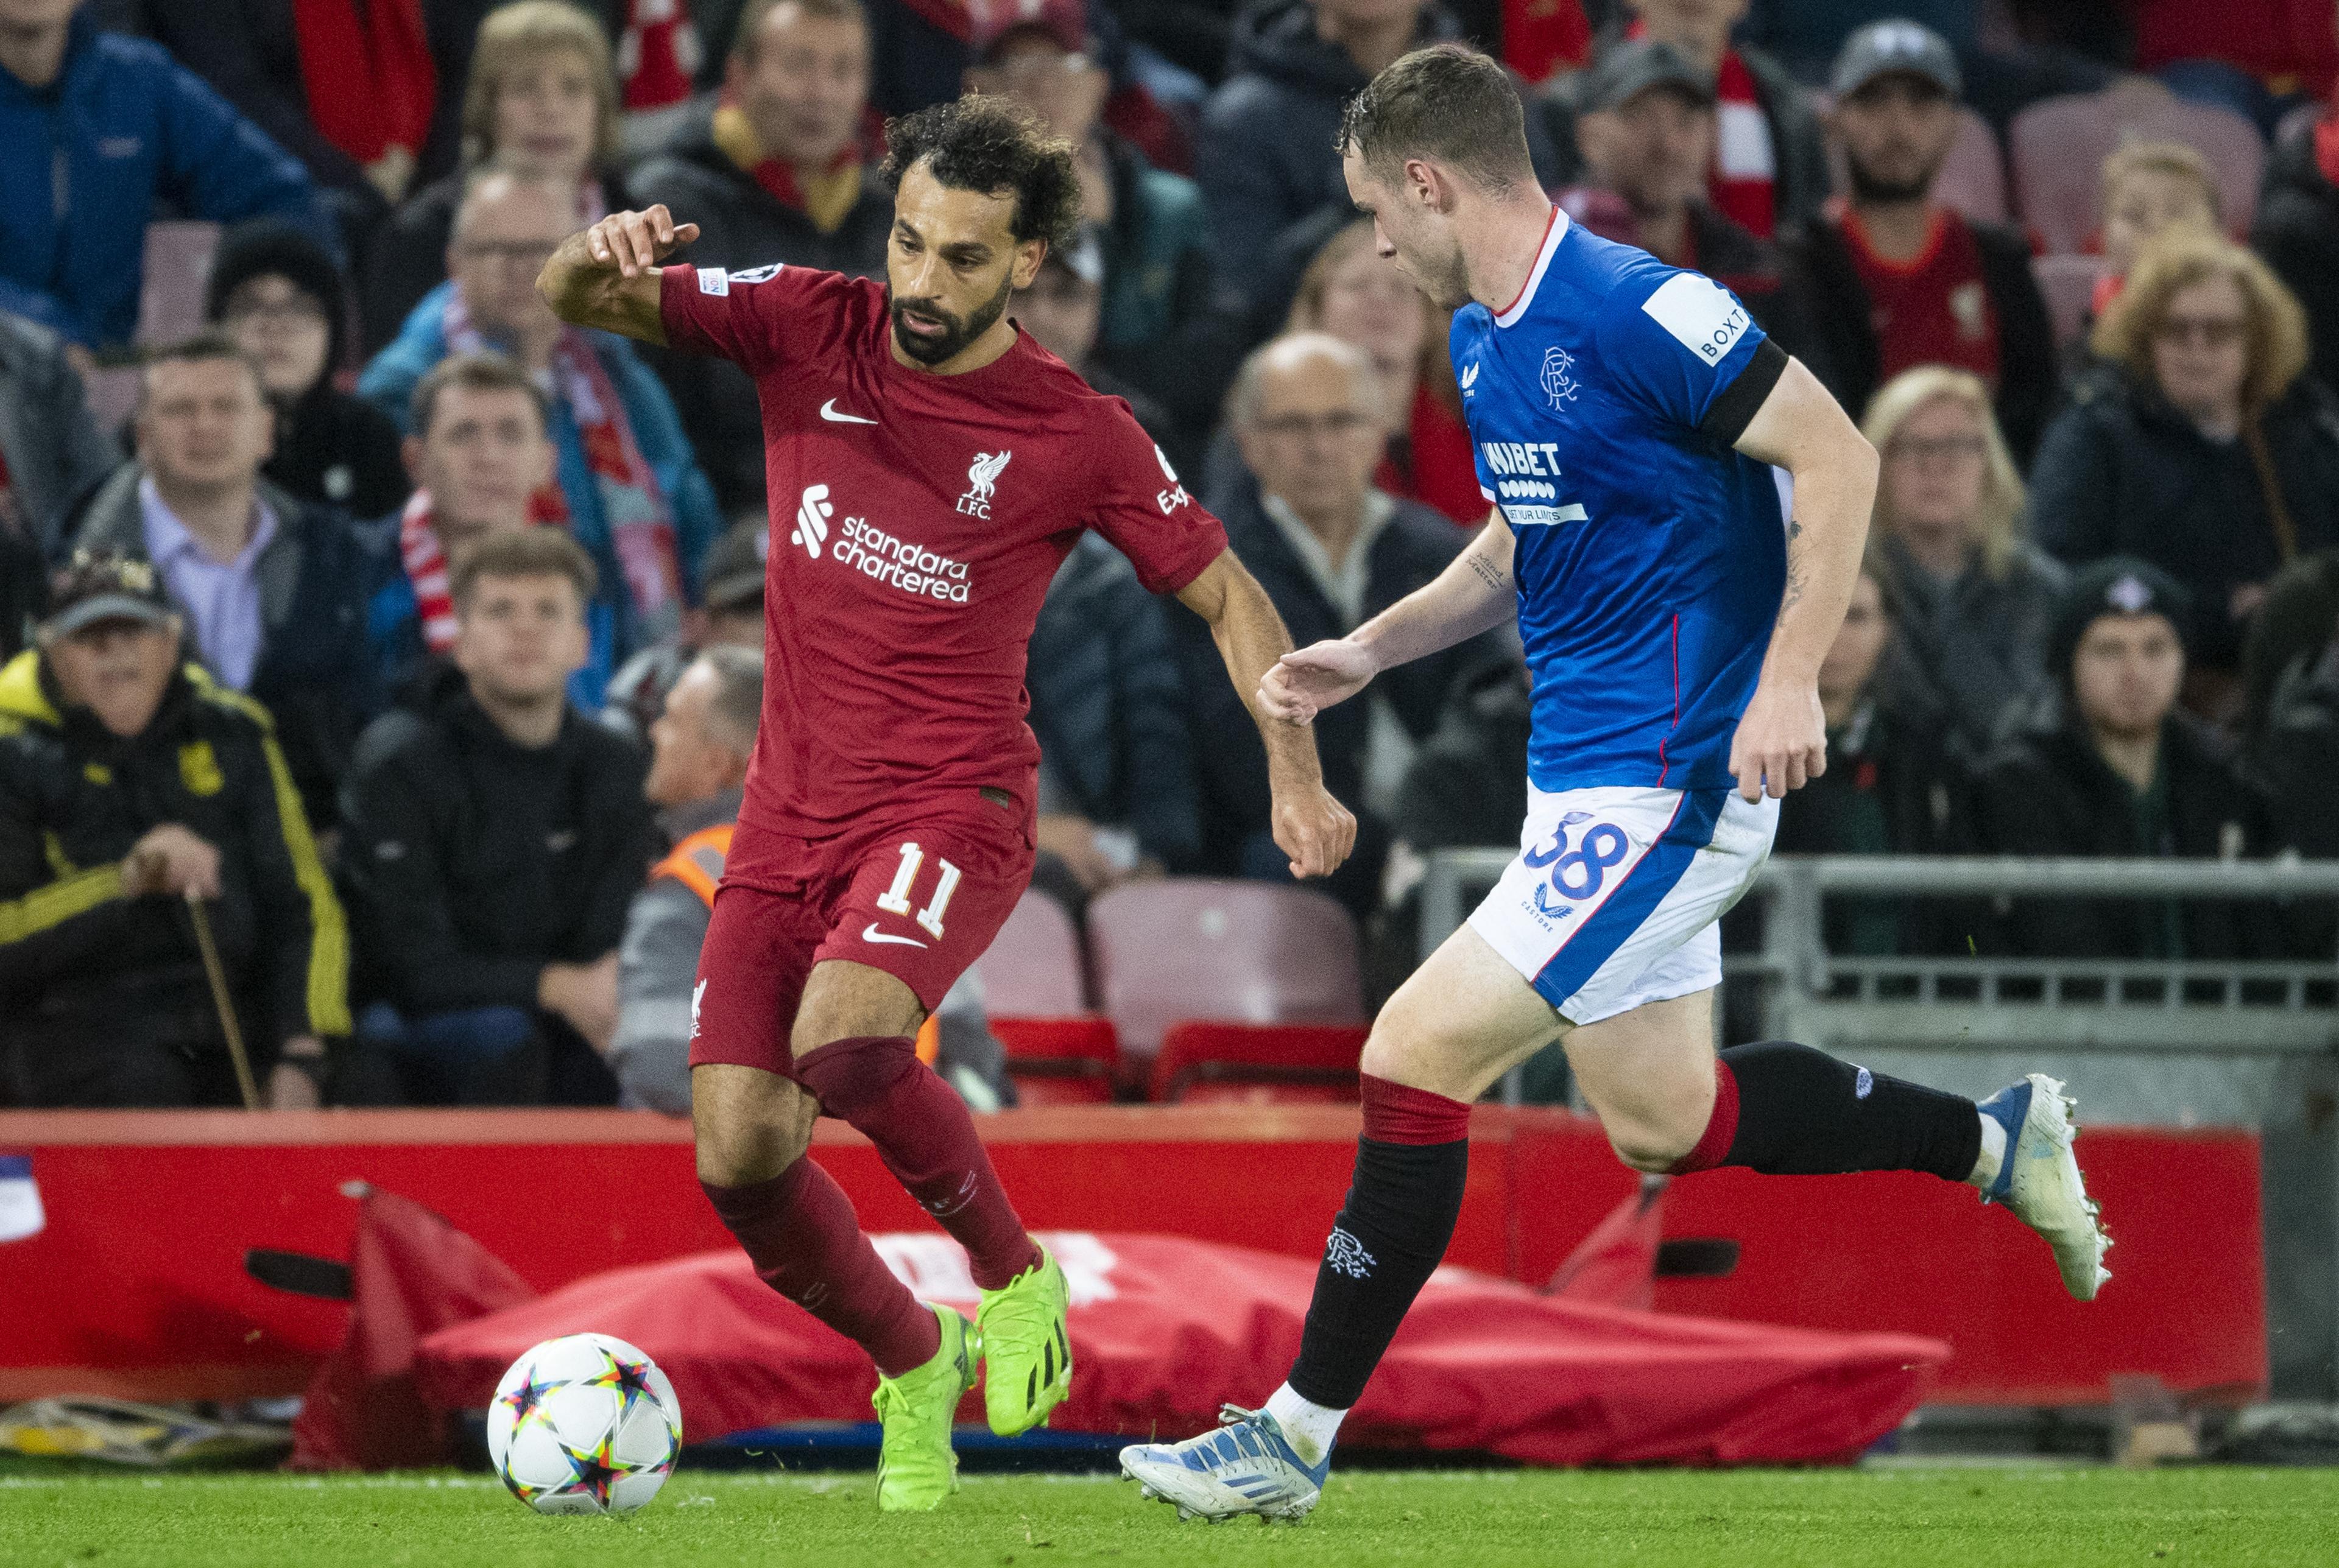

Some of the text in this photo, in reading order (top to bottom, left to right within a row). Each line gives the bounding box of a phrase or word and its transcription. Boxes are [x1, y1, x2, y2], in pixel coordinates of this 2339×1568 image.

[1701, 309, 1744, 357] BOXT
[833, 540, 972, 602] chartered
[842, 516, 971, 580] standard
[1523, 812, 1629, 901] 38
[877, 842, 961, 941] 11
[1521, 901, 1554, 933] CASTORE
